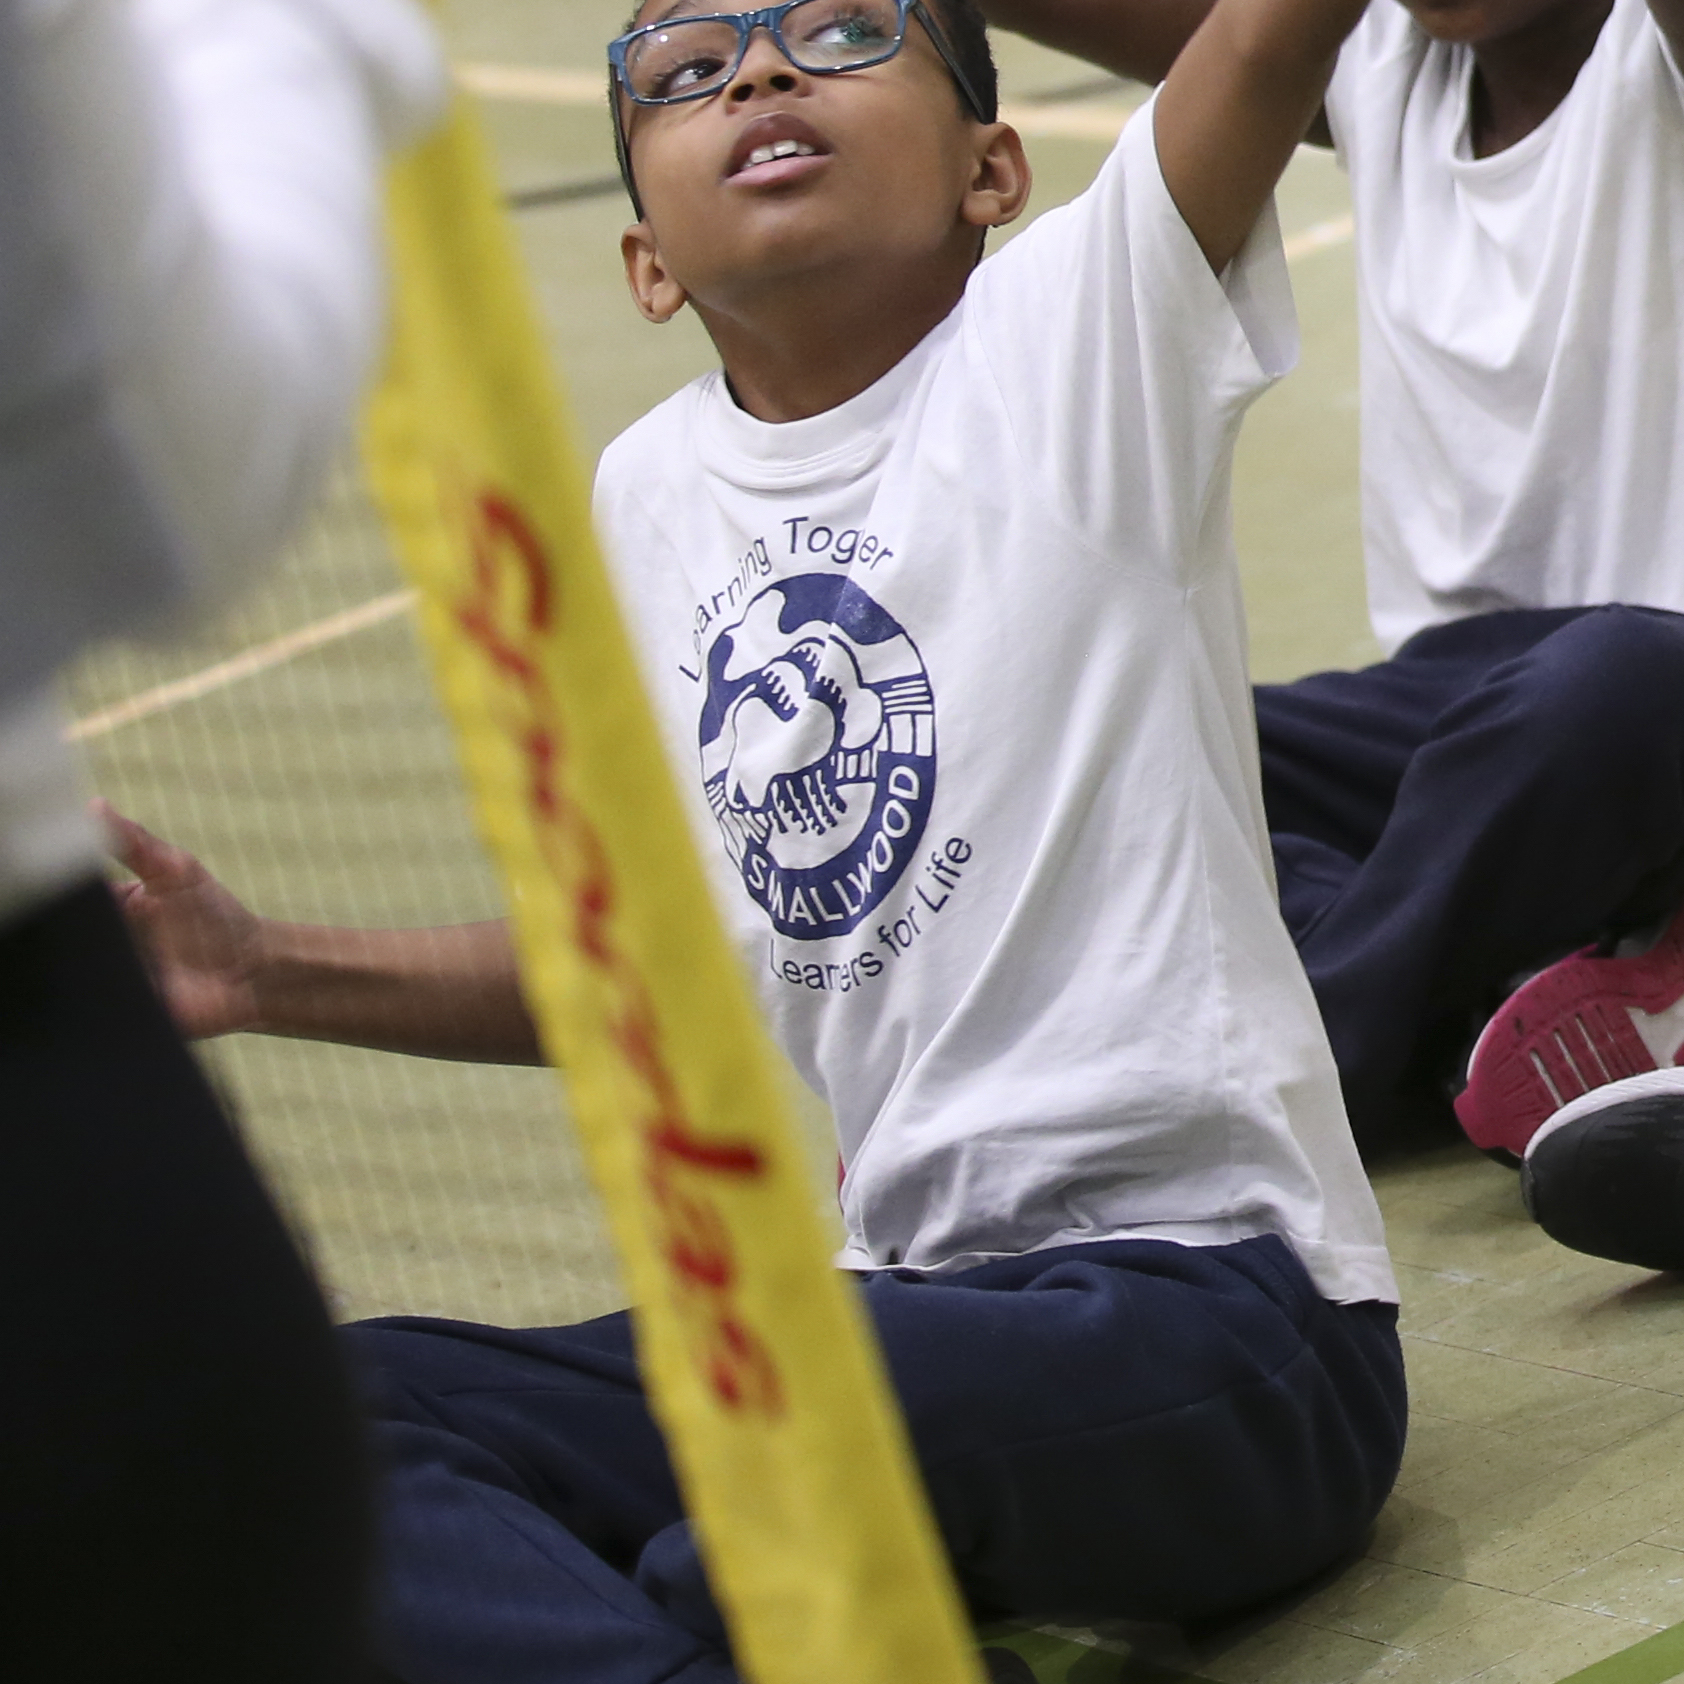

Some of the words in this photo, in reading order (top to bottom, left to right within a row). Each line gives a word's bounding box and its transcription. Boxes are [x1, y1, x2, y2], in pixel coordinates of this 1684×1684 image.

[678, 537, 773, 684] Learning
[747, 764, 921, 926] SMALLWOOD
[877, 904, 923, 957] for
[915, 835, 974, 915] Life
